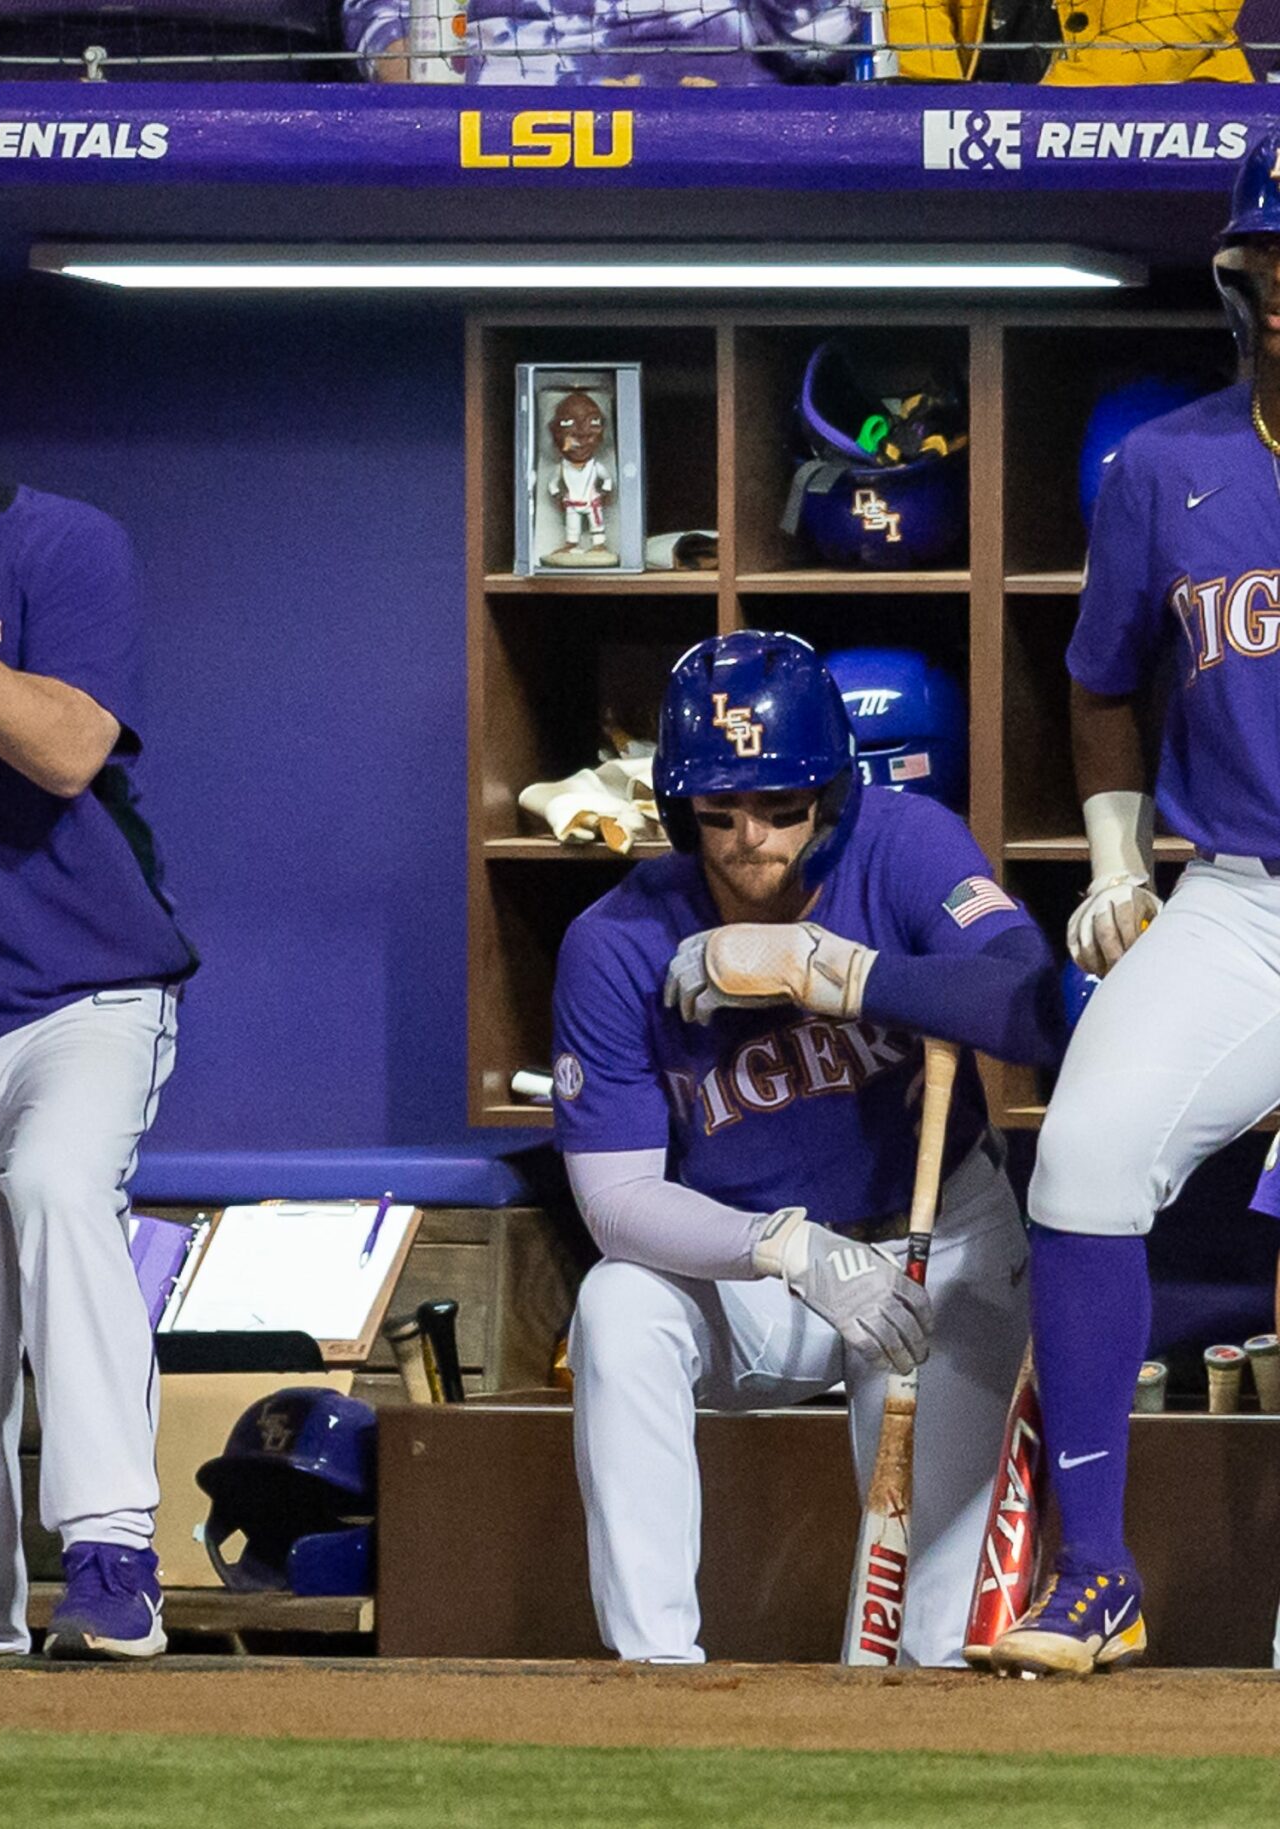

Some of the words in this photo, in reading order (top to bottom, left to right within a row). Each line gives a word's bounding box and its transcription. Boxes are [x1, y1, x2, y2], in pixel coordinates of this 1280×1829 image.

[458, 110, 634, 169] LSU
[923, 109, 1021, 170] H&E
[1036, 122, 1248, 159] RENTALS
[712, 693, 764, 758] LSU
